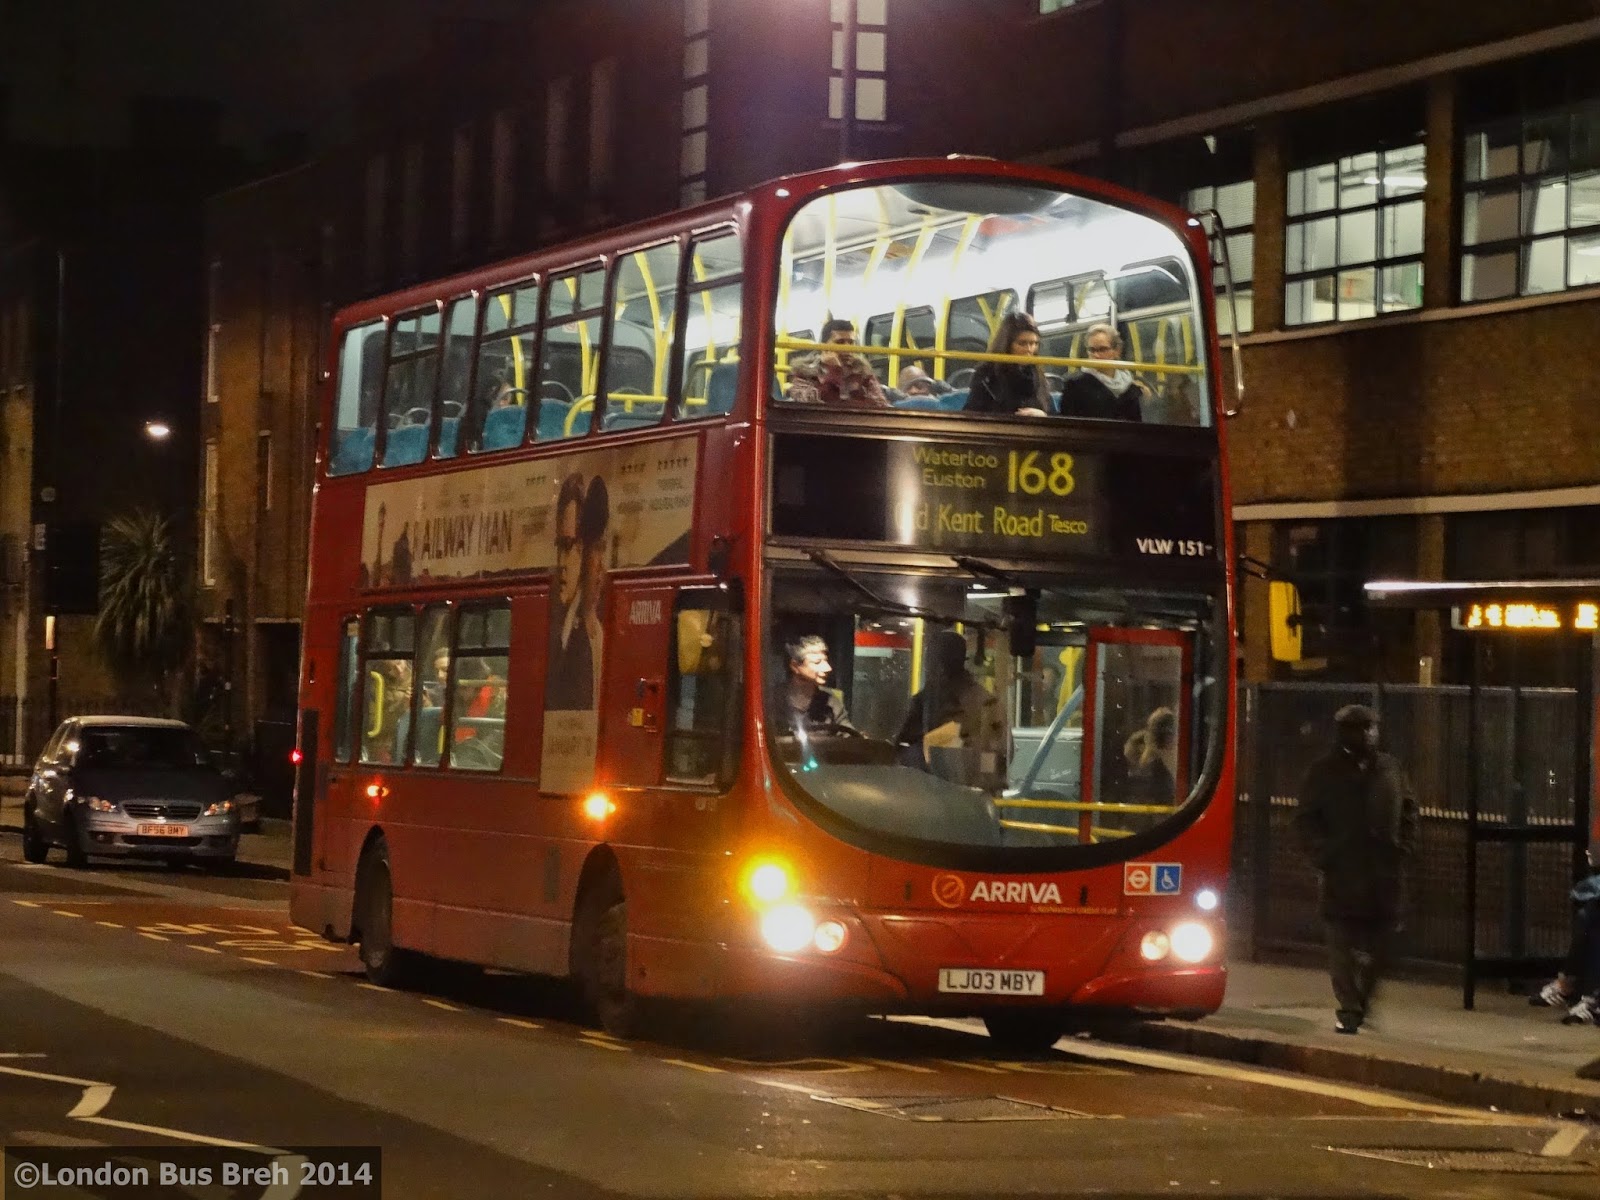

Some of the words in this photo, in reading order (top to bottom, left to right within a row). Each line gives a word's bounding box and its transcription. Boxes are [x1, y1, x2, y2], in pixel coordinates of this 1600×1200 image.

[912, 447, 998, 468] Waterloo
[923, 468, 986, 488] Euston
[1008, 451, 1075, 496] 168
[938, 504, 985, 534] Kent
[994, 506, 1044, 537] Road
[1048, 514, 1088, 535] Tesco
[1136, 538, 1174, 554] VLW
[970, 881, 1063, 905] ARRIVA
[946, 969, 995, 991] LJ03
[1001, 972, 1036, 992] MBY
